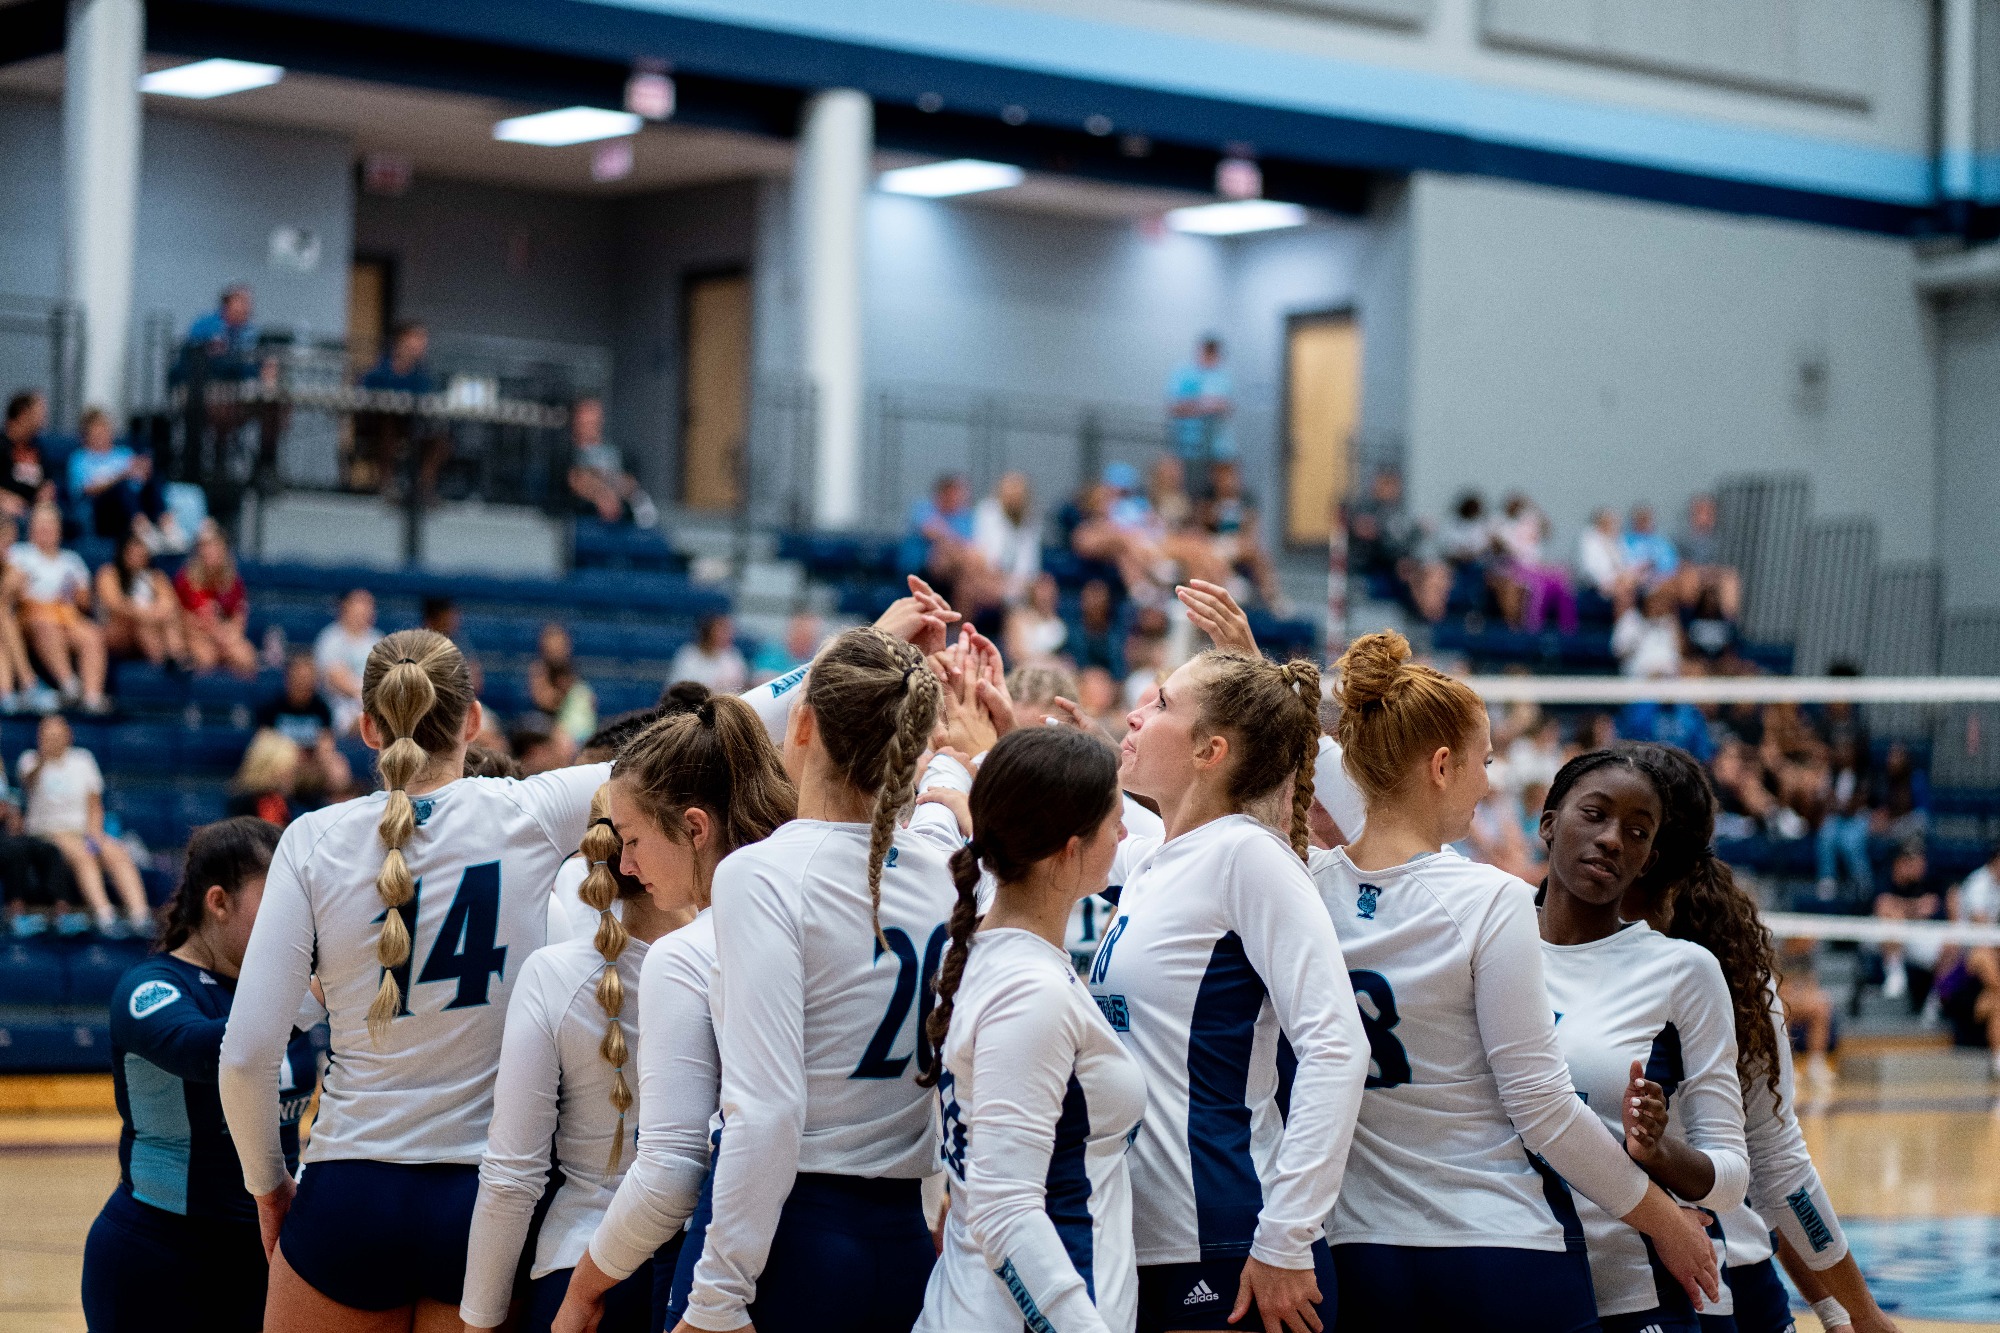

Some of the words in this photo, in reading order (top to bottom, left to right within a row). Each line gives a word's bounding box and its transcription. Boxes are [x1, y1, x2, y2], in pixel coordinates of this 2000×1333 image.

[769, 667, 809, 698] NITY
[363, 859, 509, 1021] 14
[1089, 915, 1130, 985] 18
[1786, 1186, 1834, 1254] TRINITY
[1183, 1292, 1219, 1305] adidas
